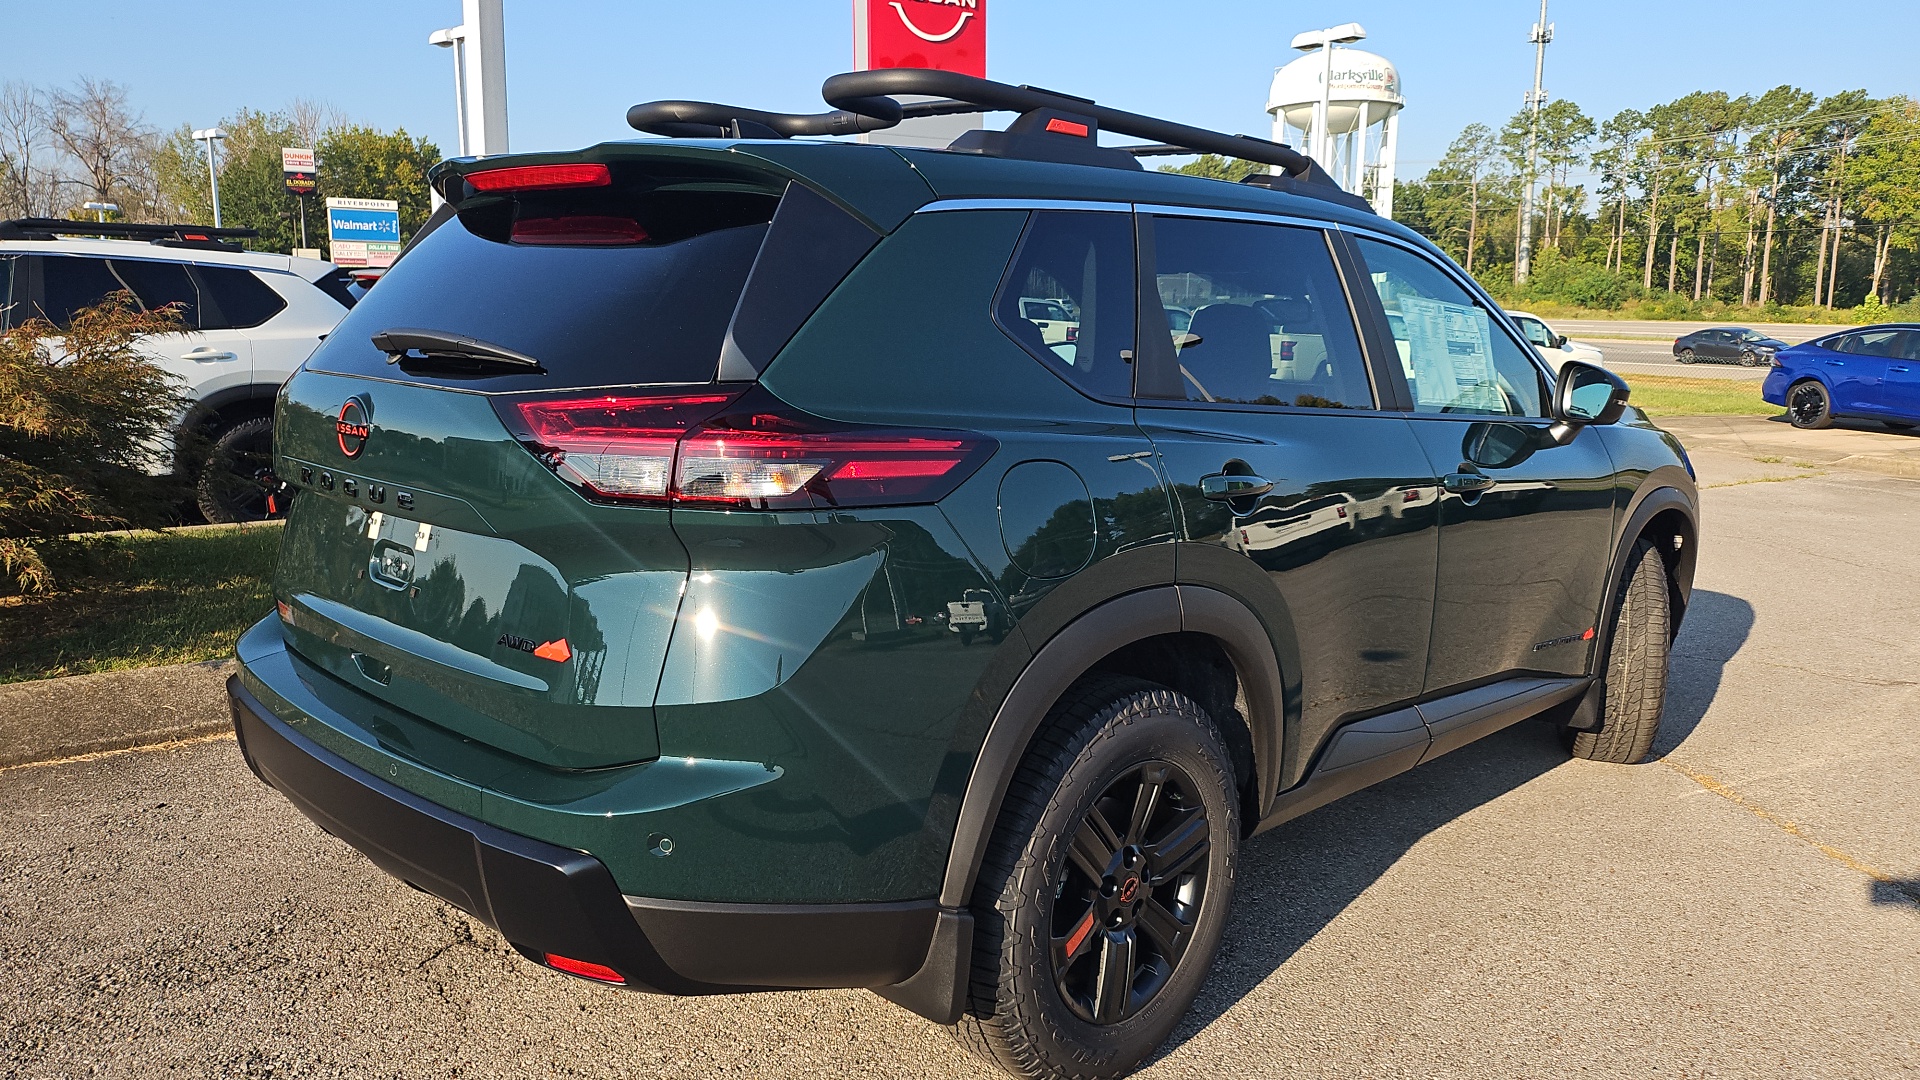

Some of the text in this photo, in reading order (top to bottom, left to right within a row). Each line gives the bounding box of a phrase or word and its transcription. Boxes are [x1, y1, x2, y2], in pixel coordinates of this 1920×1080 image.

[337, 199, 390, 207] RIVERPOINT
[333, 219, 377, 231] Walmart
[301, 466, 415, 511] ROGUE
[497, 633, 536, 653] AWD
